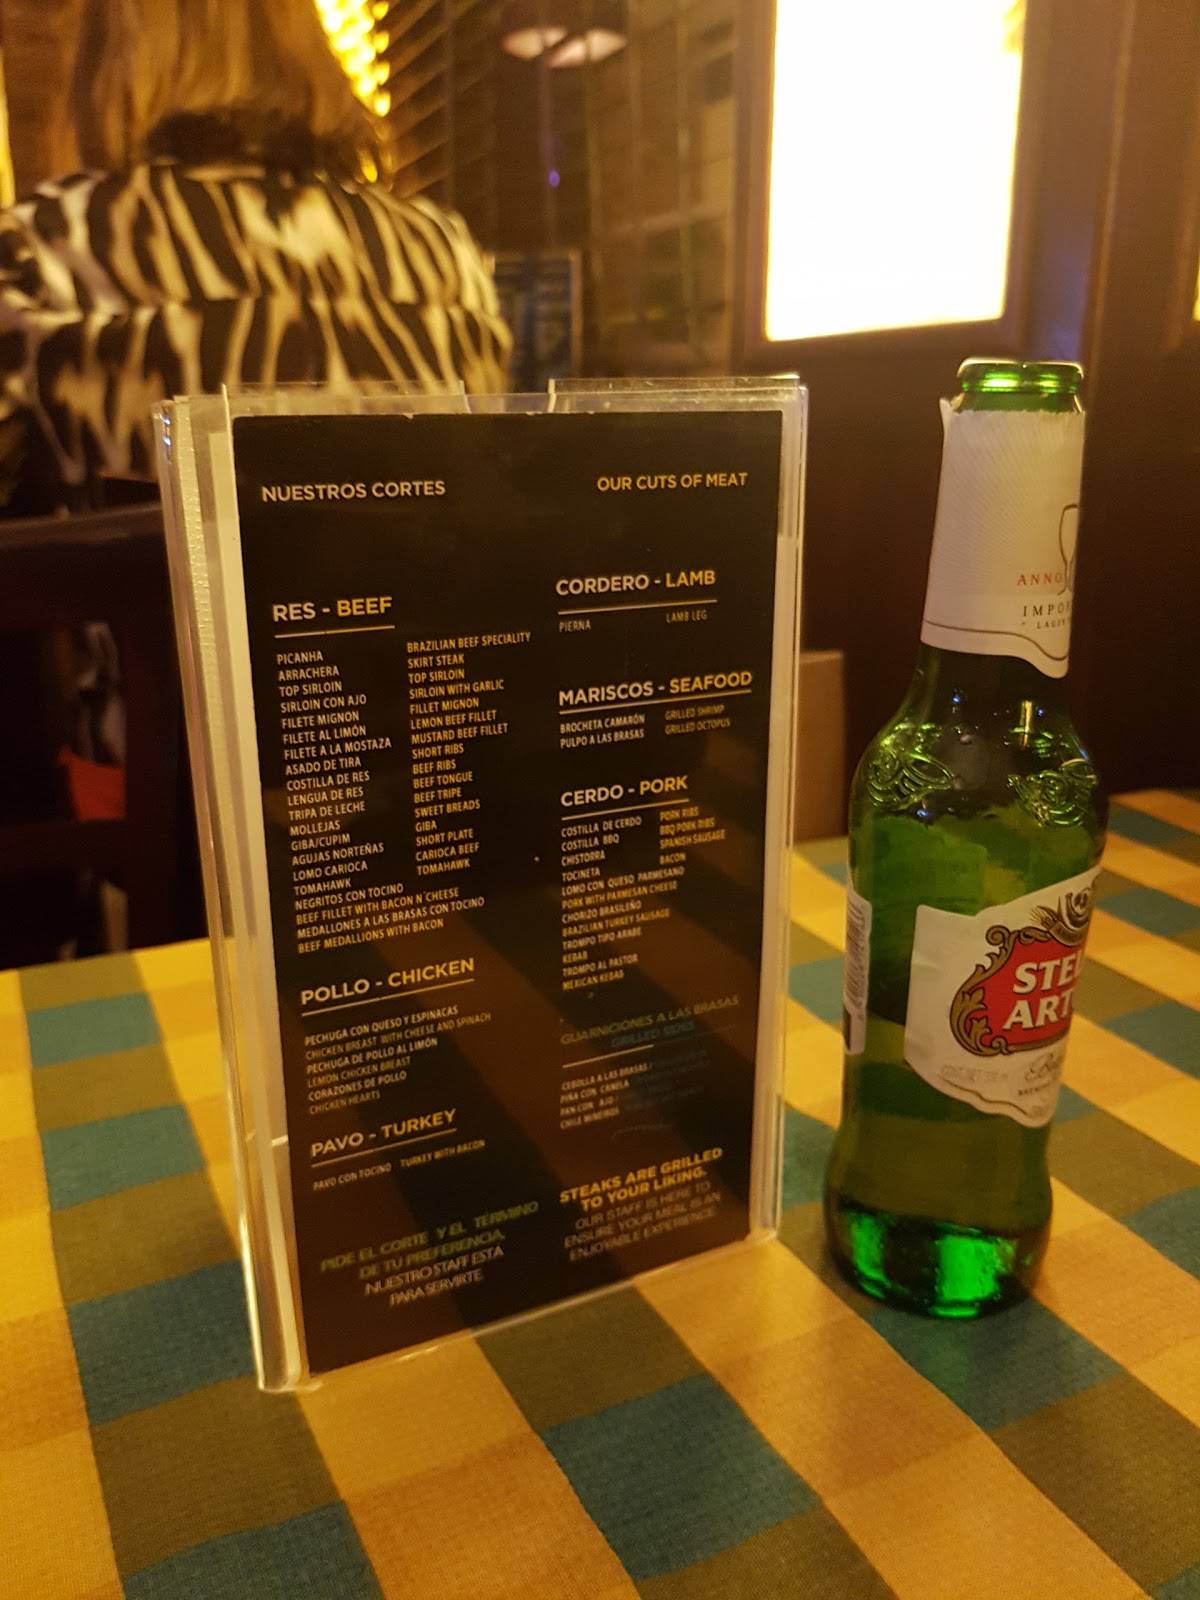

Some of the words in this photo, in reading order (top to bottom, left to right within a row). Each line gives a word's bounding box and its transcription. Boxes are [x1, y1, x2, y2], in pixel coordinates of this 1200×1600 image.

[262, 483, 367, 502] NUESTROS
[372, 481, 445, 498] CORTES
[597, 477, 631, 491] OUR
[636, 475, 677, 490] CUTS
[680, 474, 701, 488] OF
[706, 473, 747, 487] MEAT
[556, 574, 649, 595] CORDERO
[666, 570, 715, 588] LAMB
[1017, 572, 1063, 585] ANNO
[273, 602, 315, 622] RES
[337, 597, 392, 617] BEEF
[666, 611, 689, 622] LAMB
[692, 610, 707, 621] LEG
[560, 620, 591, 631] PIERNA
[407, 639, 455, 653] BRAZILIAN
[458, 637, 479, 648] BEEF
[482, 632, 530, 646] SPECIALITY
[277, 651, 323, 665] PICANHA
[408, 657, 433, 669] SKIRT
[437, 654, 464, 666] STEAK
[279, 666, 339, 681] ARRACHERA
[409, 673, 426, 684] TOP
[430, 669, 464, 682] SIRLOIN
[670, 671, 752, 693] SEAFOOD
[279, 685, 300, 697] TOP
[302, 681, 342, 695] SIRLOIN
[410, 686, 445, 699] SIRLOIN
[447, 683, 470, 695] WITH
[473, 680, 504, 693] GARLIC
[560, 681, 653, 706] MARISCOS
[281, 699, 320, 713] SIRLOIN
[324, 696, 344, 708] CON
[348, 694, 366, 706] AJO
[410, 702, 439, 714] FILLET
[442, 698, 479, 711] MIGNON
[282, 715, 315, 729] FILETE
[318, 711, 359, 725] MIGNON
[411, 716, 443, 730] LEMON
[446, 714, 466, 726] BEEF
[469, 710, 496, 723] FILLET
[561, 719, 602, 734] BROCHETA
[283, 731, 316, 744] FILETE
[319, 729, 331, 740] AL
[412, 729, 454, 744] MUSTARD
[458, 727, 478, 739] BEEF
[481, 723, 508, 736] FILLET
[561, 736, 587, 748] PULPO
[589, 735, 595, 745] A
[597, 733, 612, 743] LAS
[614, 729, 644, 741] BRASAS
[284, 746, 317, 760] FILETE
[320, 745, 326, 756] A
[330, 743, 341, 755] LA
[345, 737, 391, 753] MOSTAZA
[412, 746, 442, 759] SHORT
[445, 743, 464, 755] RIBS
[285, 761, 320, 775] ASADO
[324, 760, 336, 771] DE
[340, 757, 361, 769] TIRA
[413, 762, 434, 774] BEEF
[437, 759, 456, 771] RIBS
[287, 775, 334, 791] COSTILLA
[337, 773, 349, 785] DE
[353, 771, 370, 783] RES
[413, 776, 434, 789] BEEF
[437, 771, 472, 786] TONGUE
[640, 775, 688, 795] PORK
[288, 791, 328, 806] LENGUA
[331, 789, 343, 800] DE
[347, 787, 363, 799] RES
[414, 791, 435, 803] BEEF
[438, 788, 461, 800] TRIPE
[561, 785, 623, 807] CERDO
[289, 807, 317, 821] TRIPA
[320, 806, 332, 817] DE
[336, 802, 365, 815] LECHE
[415, 804, 444, 818] SWEET
[447, 799, 480, 813] BREADS
[290, 820, 340, 836] MOLLEJAS
[416, 820, 437, 832] GIBA
[562, 823, 599, 837] COSTILLA
[603, 821, 613, 831] DE
[615, 816, 641, 829] CERDO
[291, 834, 350, 850] GIBA/CUPIM
[416, 833, 445, 846] SHORT
[448, 828, 473, 842] PLATE
[562, 837, 599, 851] COSTILLA
[292, 850, 330, 866] AGUJAS
[416, 846, 456, 861] CARIOCA
[459, 842, 479, 855] BEEF
[293, 867, 322, 881] LOMO
[325, 860, 367, 876] CARIOCA
[417, 858, 470, 875] TOMAHAWK
[294, 878, 351, 896] TOMAHAWK
[295, 893, 343, 910] NEGRITOS
[346, 889, 365, 902] CON
[368, 883, 403, 898] TOCINO
[562, 883, 585, 896] LOMO
[588, 880, 604, 891] CON
[296, 911, 319, 925] BEEF
[322, 905, 352, 920] FILLET
[355, 901, 379, 915] WITH
[382, 895, 413, 910] BACON
[297, 918, 361, 939] MEDALLONES
[364, 916, 370, 927] A
[373, 913, 389, 925] LAS
[393, 906, 427, 922] BRASAS
[430, 903, 448, 916] CON
[451, 896, 484, 912] TOCINO
[298, 940, 320, 953] BEEF
[324, 929, 384, 949] MEDALLIONS
[387, 924, 410, 938] WITH
[413, 919, 444, 933] BACON
[302, 978, 369, 1004] POLLO
[388, 958, 474, 988] CHICKEN
[305, 1028, 348, 1046] PECHUGA
[351, 1024, 369, 1037] CON
[372, 1017, 401, 1032] QUESO
[404, 1015, 409, 1026] Y
[412, 1005, 458, 1024] ESPINACAS
[307, 1056, 349, 1074] PECHUGA
[352, 1053, 363, 1064] DE
[366, 1047, 394, 1061] POLLO
[397, 1044, 406, 1054] AL
[312, 1130, 363, 1156] PAVO
[381, 1108, 456, 1140] TURKEY
[560, 1176, 620, 1204] STEAKS
[626, 1166, 656, 1185] ARE
[660, 1148, 722, 1176] GRILLED
[581, 1194, 602, 1211] TO
[608, 1181, 649, 1203] YOUR
